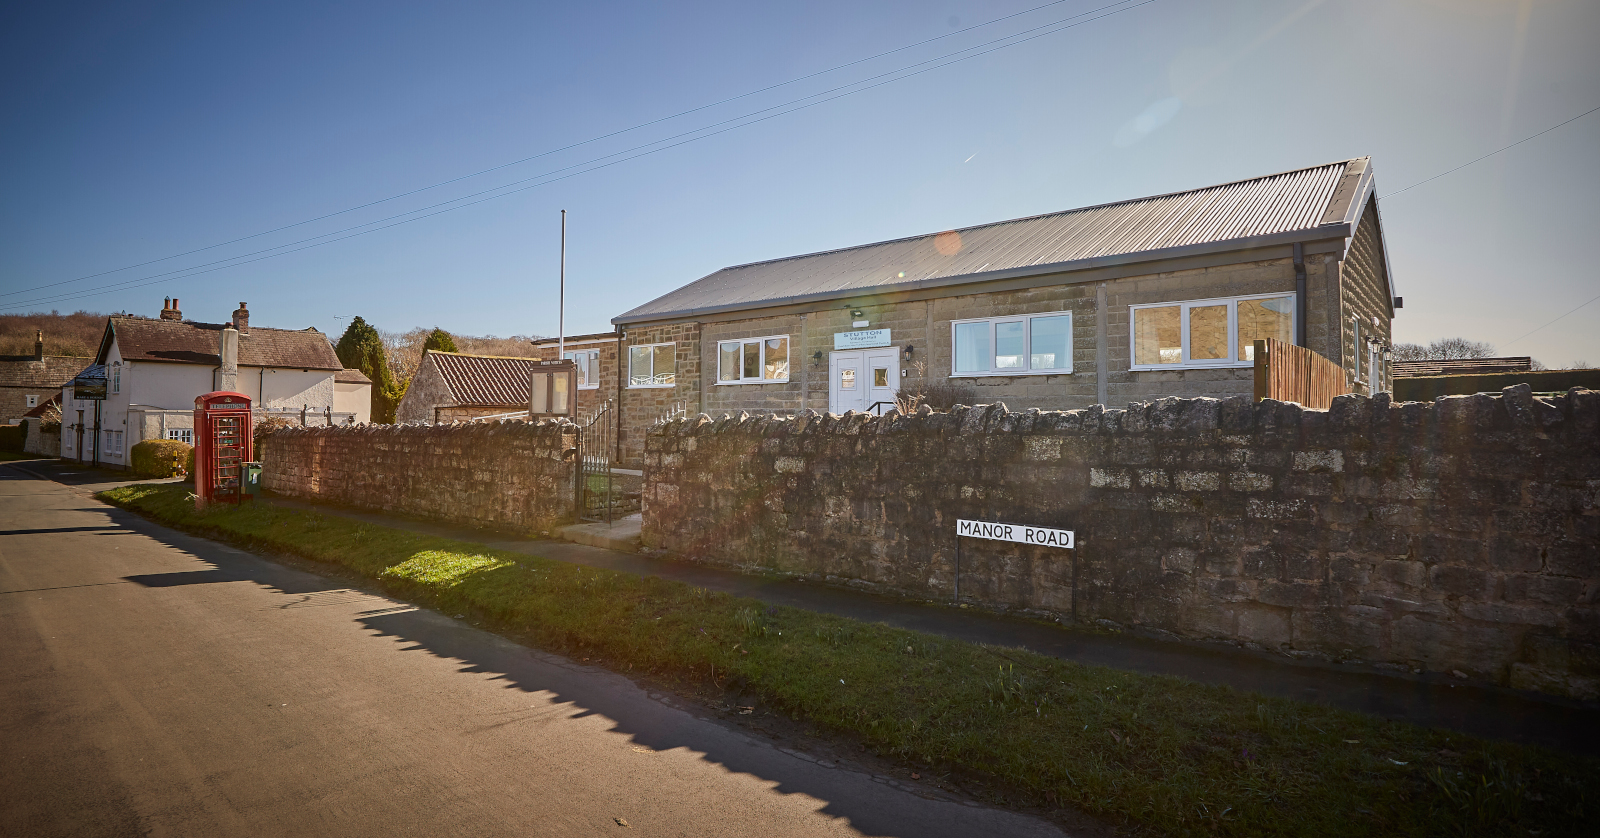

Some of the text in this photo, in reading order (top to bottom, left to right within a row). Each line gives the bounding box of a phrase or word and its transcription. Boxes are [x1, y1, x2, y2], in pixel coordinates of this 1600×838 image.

[843, 330, 882, 338] STUTTON
[960, 521, 1069, 546] MANOR ROAD
